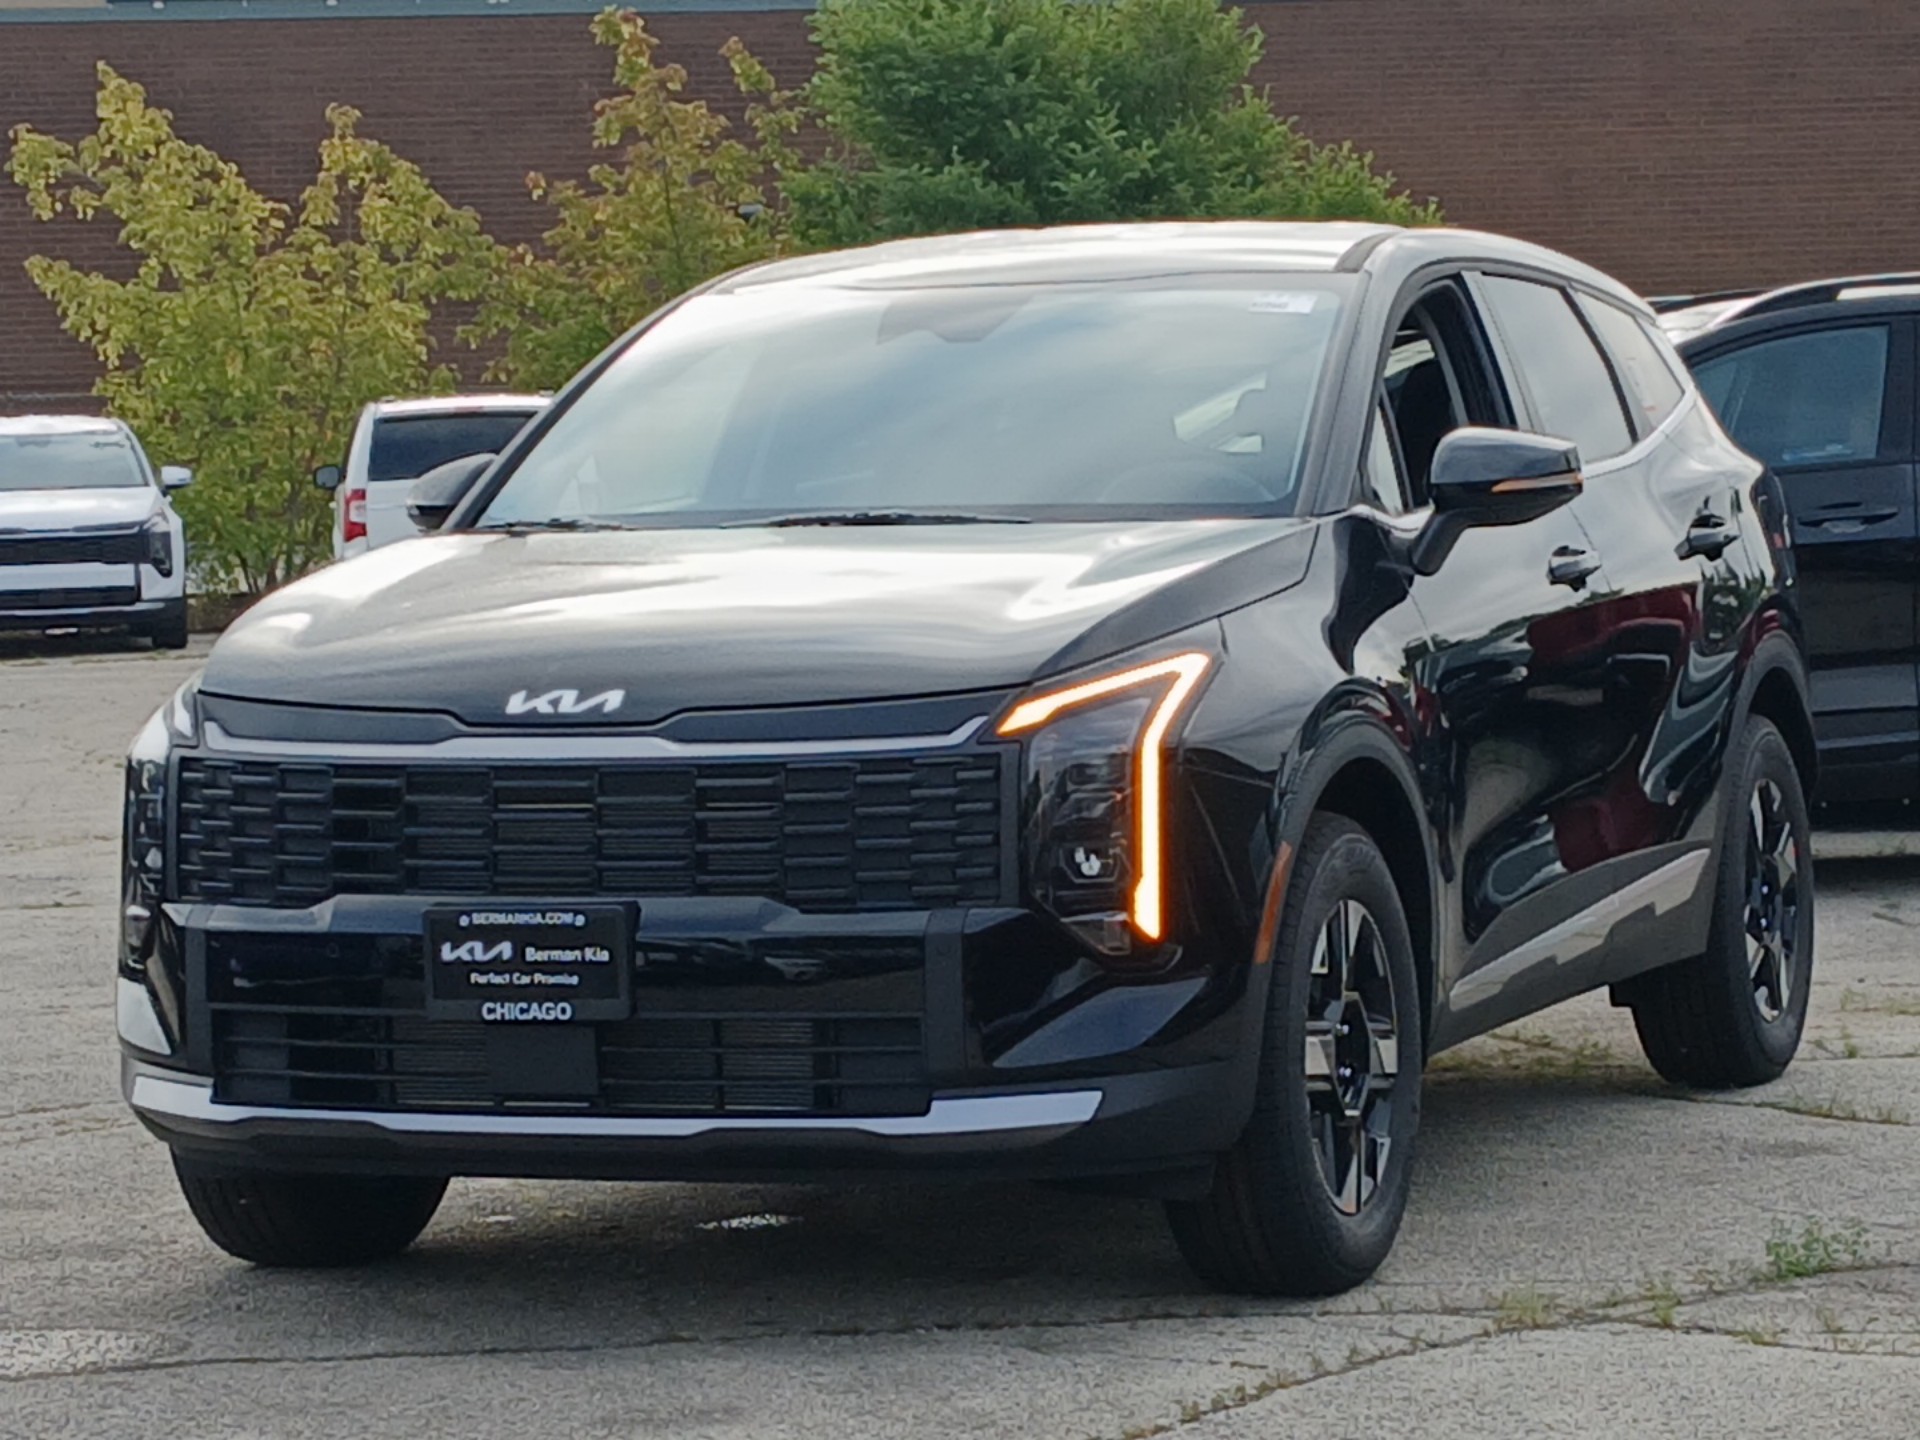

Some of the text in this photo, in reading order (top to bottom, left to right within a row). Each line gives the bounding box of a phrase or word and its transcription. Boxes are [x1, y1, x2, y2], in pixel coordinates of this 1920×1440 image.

[505, 688, 625, 714] KIA
[525, 947, 610, 962] Berman Kia
[512, 972, 532, 985] Car
[481, 1002, 572, 1020] CHICAGO
